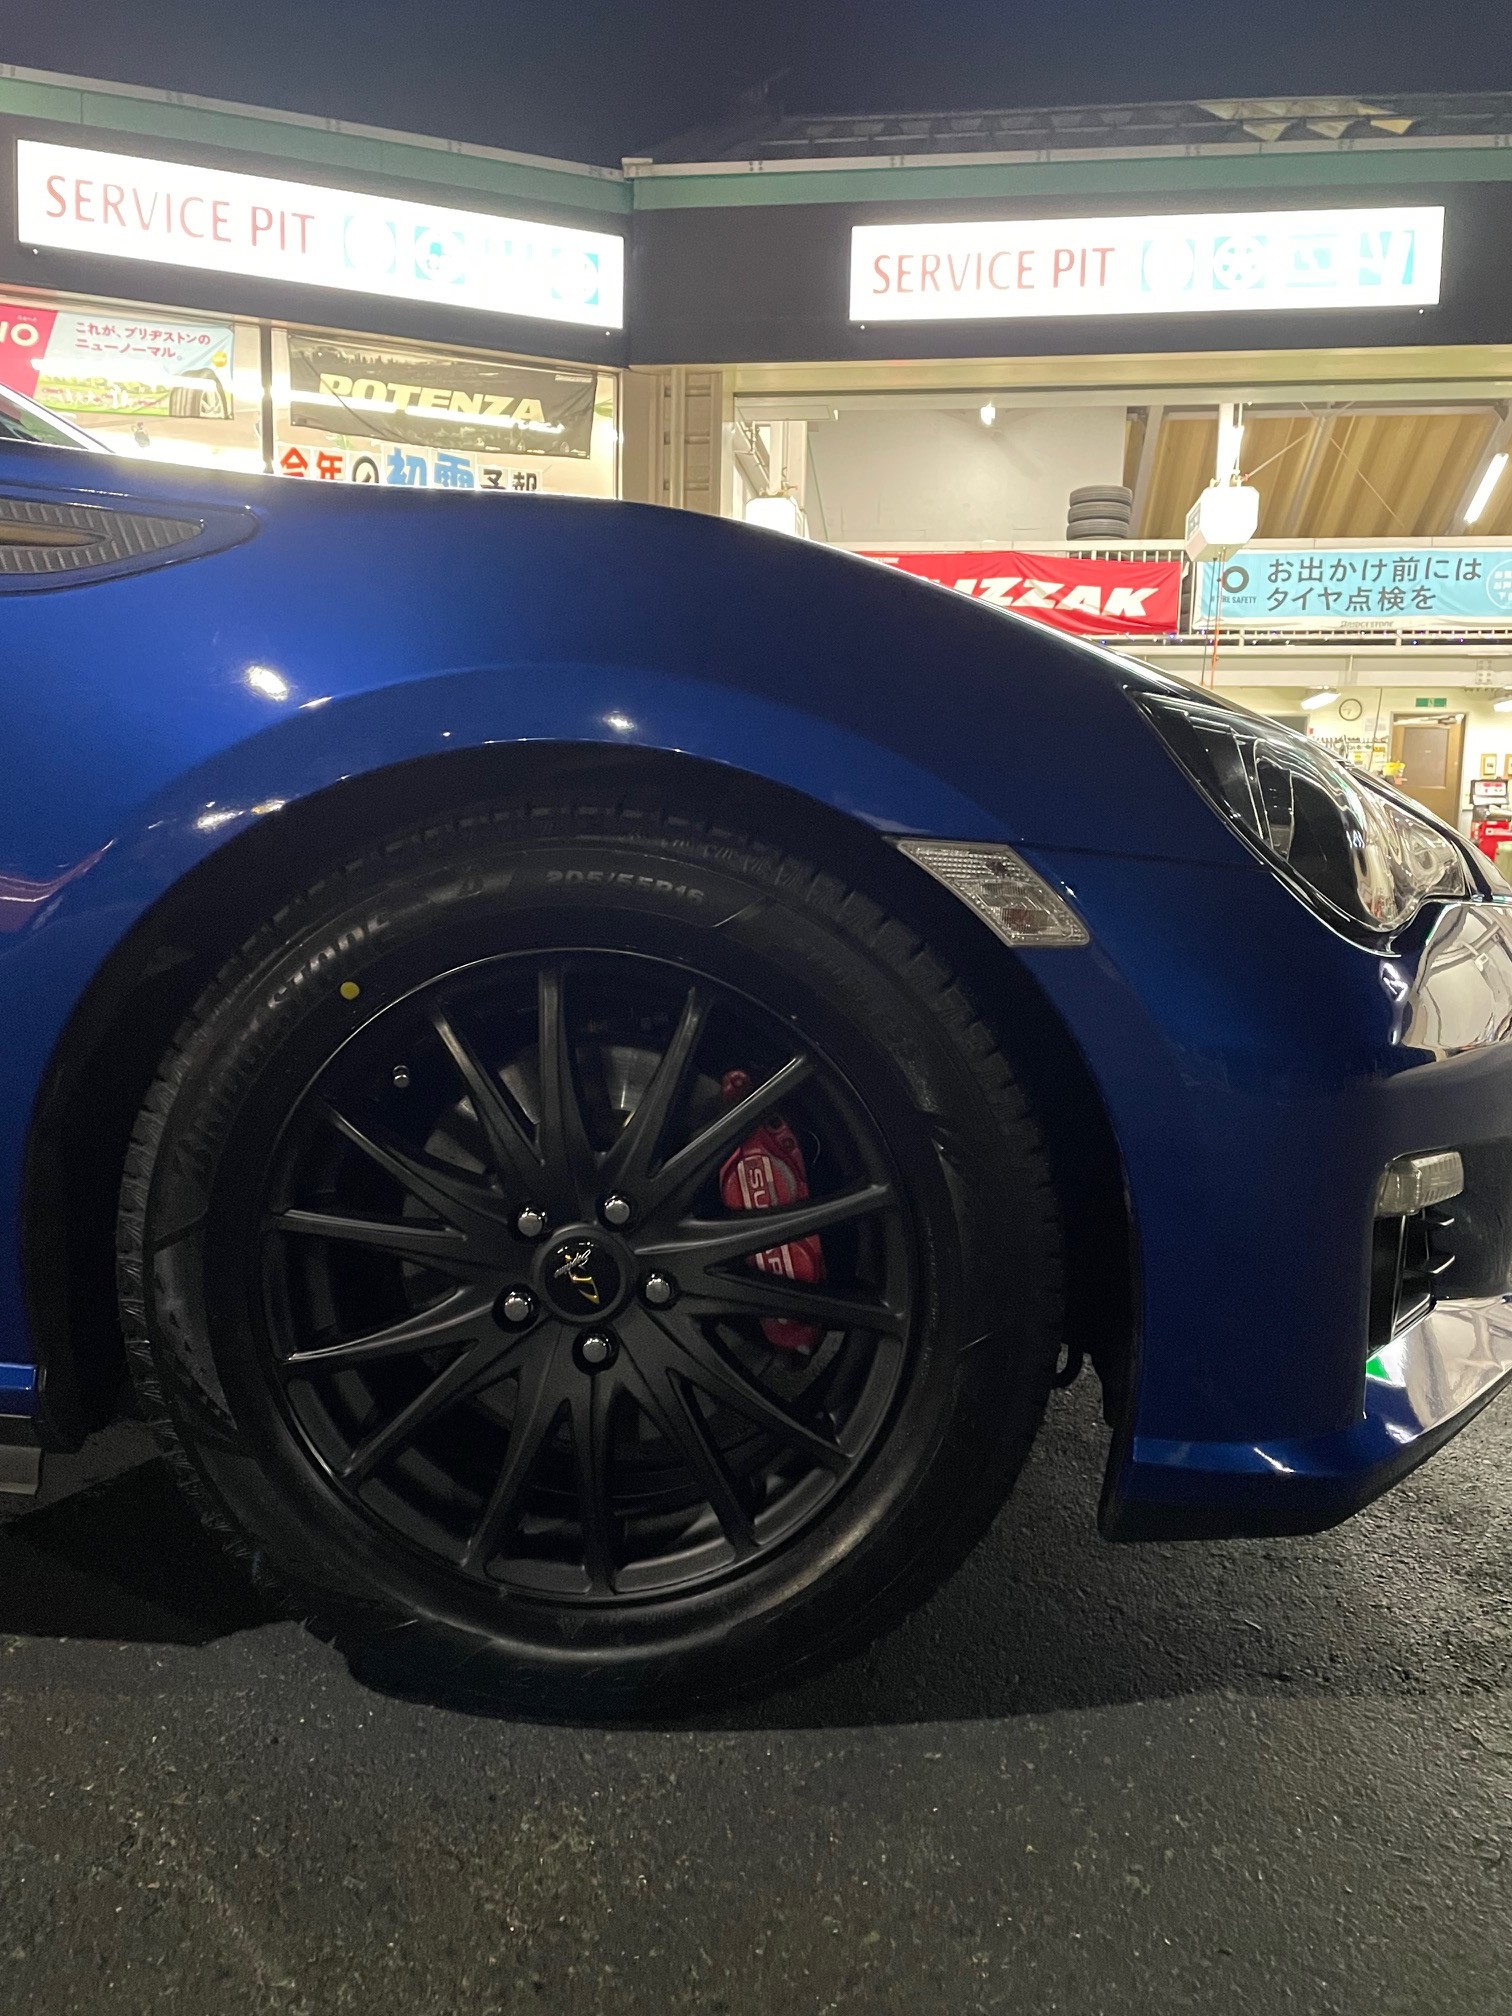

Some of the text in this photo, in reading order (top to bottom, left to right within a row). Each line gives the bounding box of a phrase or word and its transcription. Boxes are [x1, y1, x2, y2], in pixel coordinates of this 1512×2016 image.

[46, 174, 315, 254] SERVICE PIT
[872, 247, 1116, 294] SERVICE PIT
[75, 321, 211, 345] これが、ブリヂストンの
[75, 338, 183, 361] ニューノーマル。
[318, 373, 546, 424] POTENZA
[1268, 556, 1482, 583] お出かけ前には
[1231, 596, 1257, 604] SAFETY
[1266, 586, 1437, 612] タイヤ点検を
